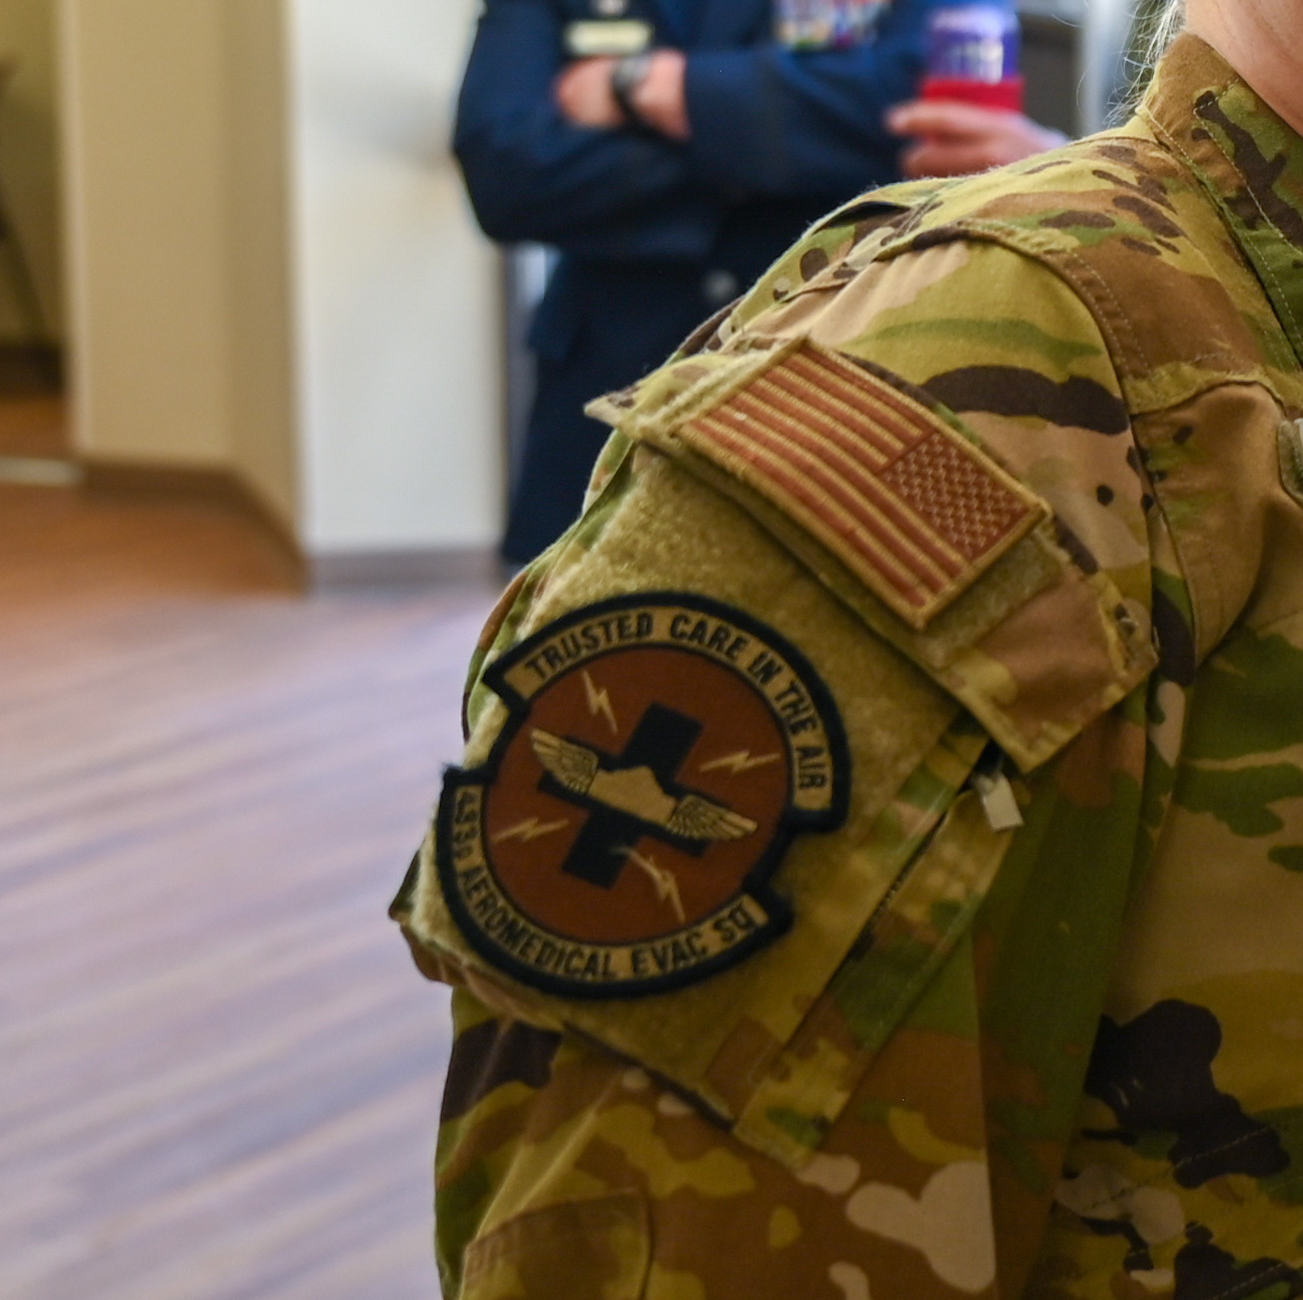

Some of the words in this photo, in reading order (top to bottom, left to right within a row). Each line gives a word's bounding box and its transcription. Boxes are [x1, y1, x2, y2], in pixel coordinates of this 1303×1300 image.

[524, 612, 654, 680] TRUSTED
[669, 614, 748, 661] CARE
[748, 652, 784, 686] IN
[774, 680, 818, 735] THE
[796, 746, 828, 790] AIR
[463, 866, 618, 978] AEROMEDICAL
[631, 932, 708, 974] EVAC
[713, 902, 753, 942] SQ
